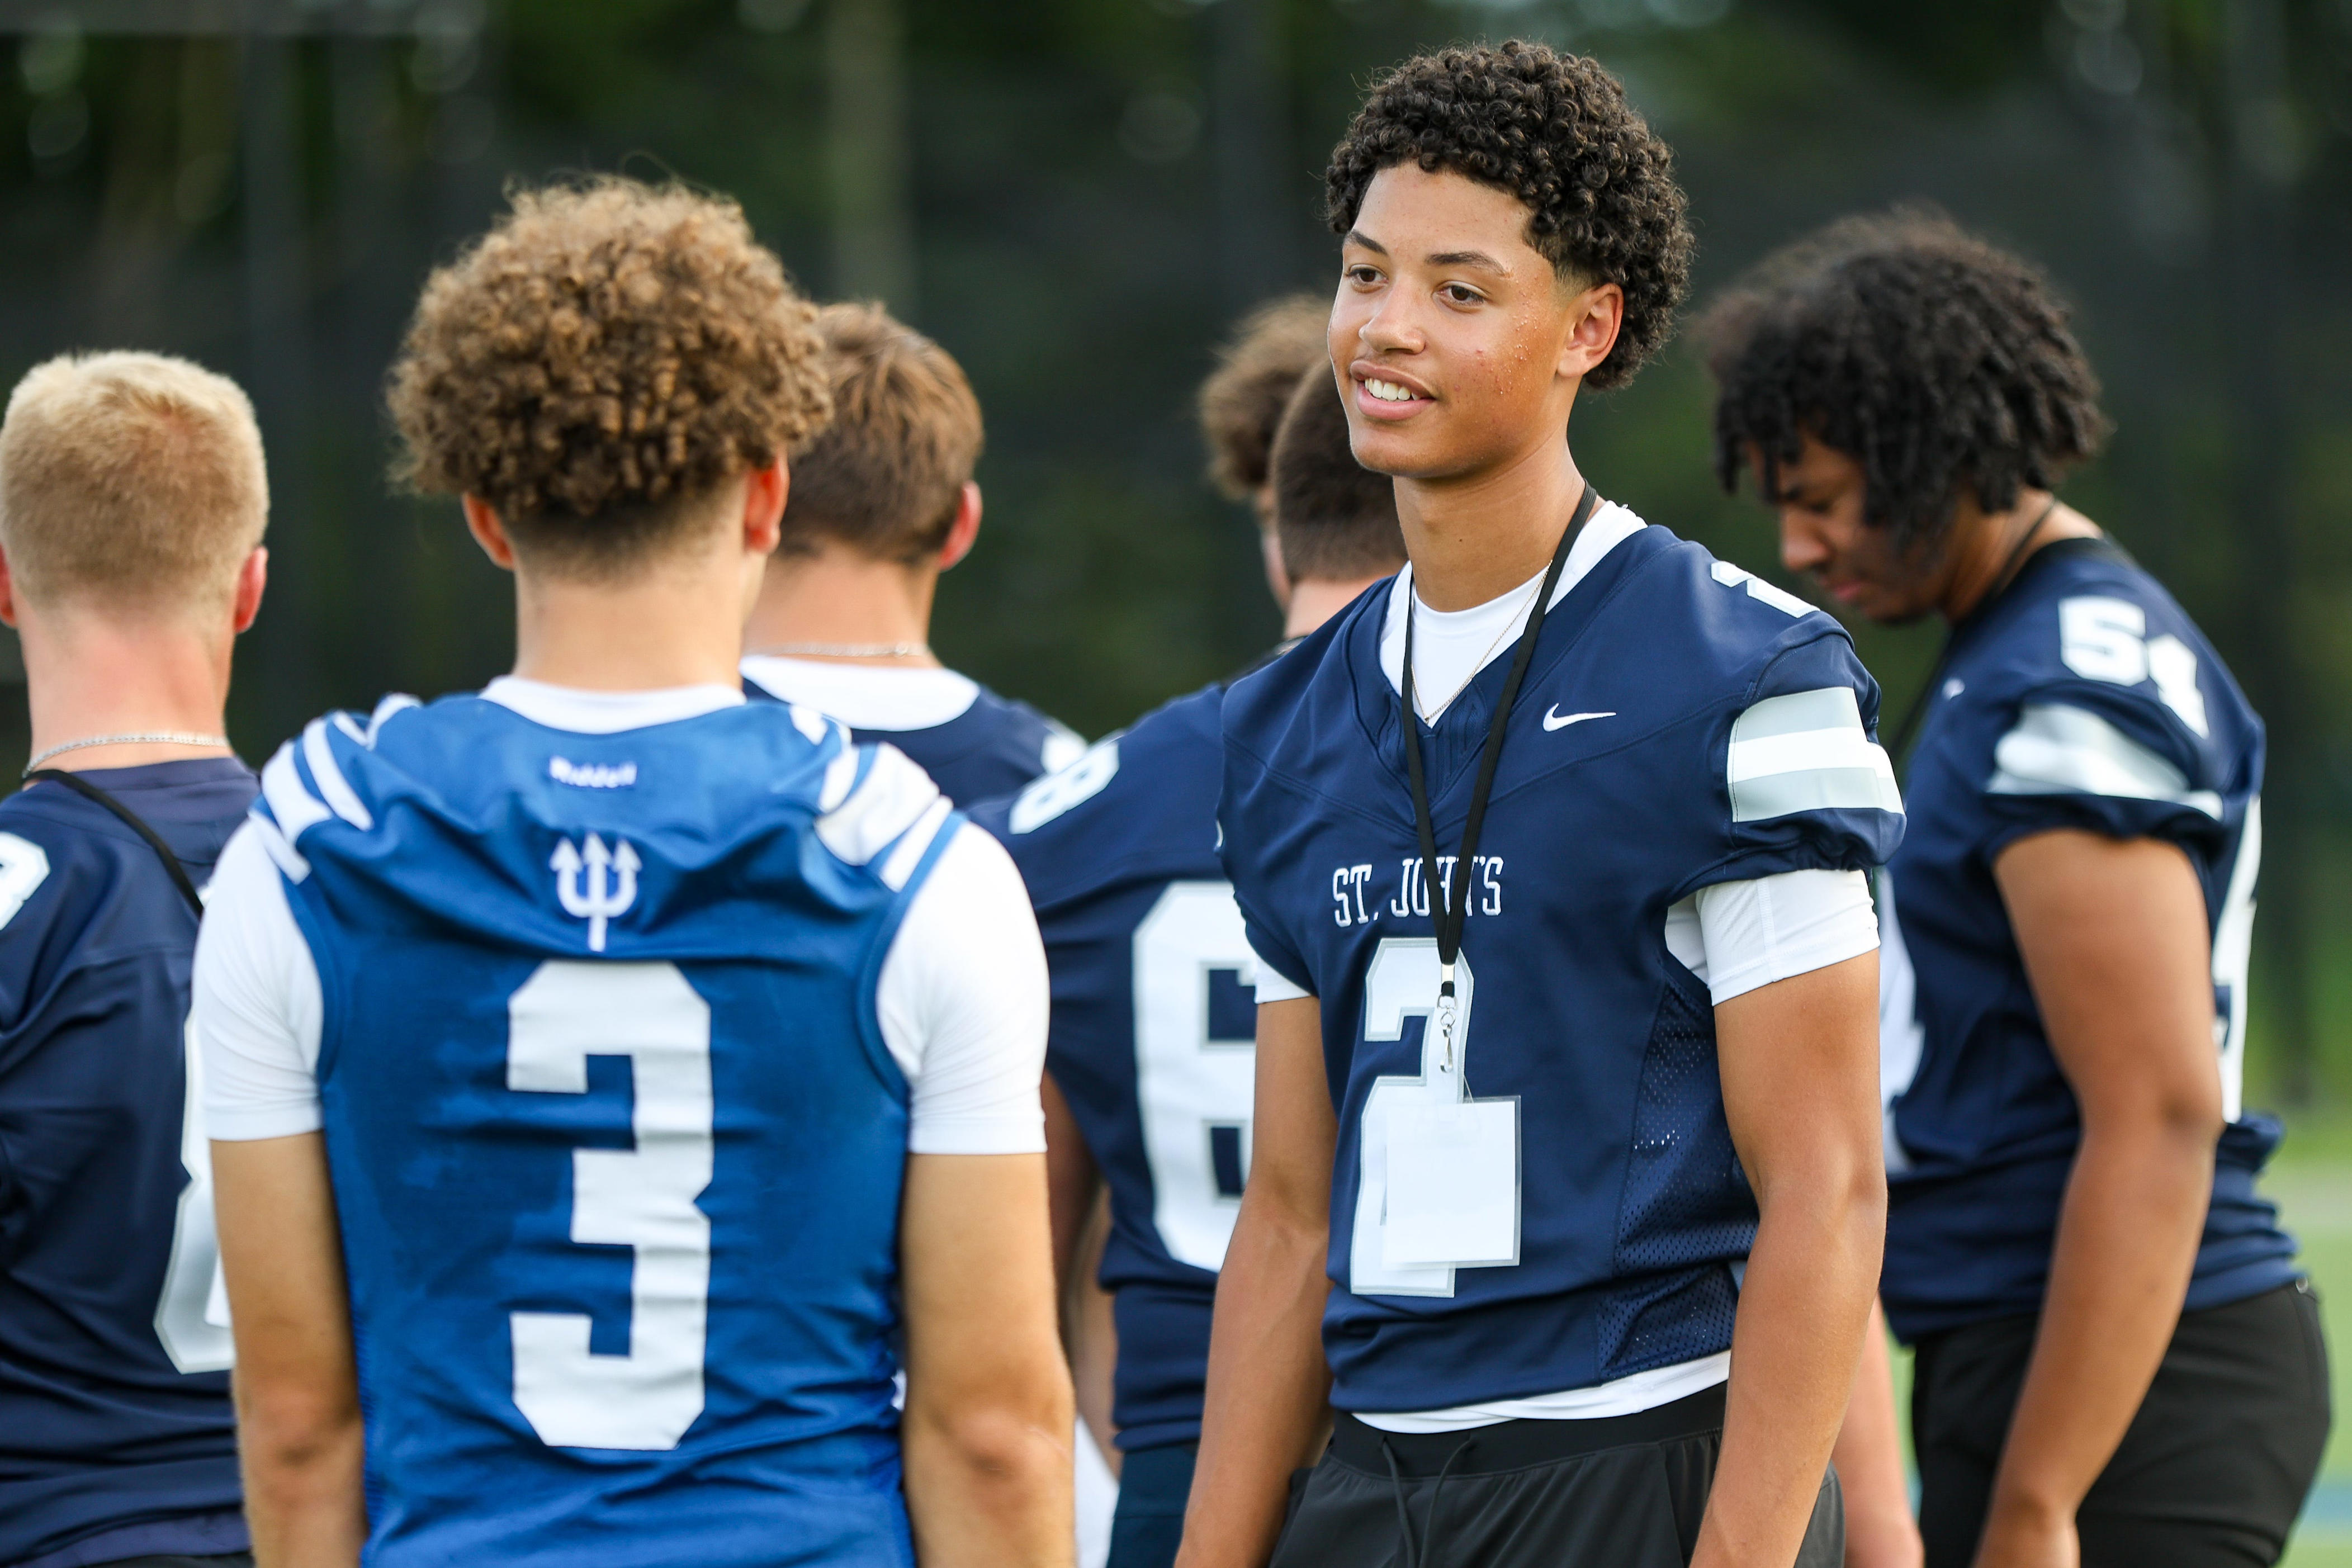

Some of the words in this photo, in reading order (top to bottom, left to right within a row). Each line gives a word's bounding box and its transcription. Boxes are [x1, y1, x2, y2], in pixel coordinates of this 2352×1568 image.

[1332, 864, 1379, 927] ST.
[506, 959, 714, 1452] 3
[1351, 937, 1474, 1298] 2
